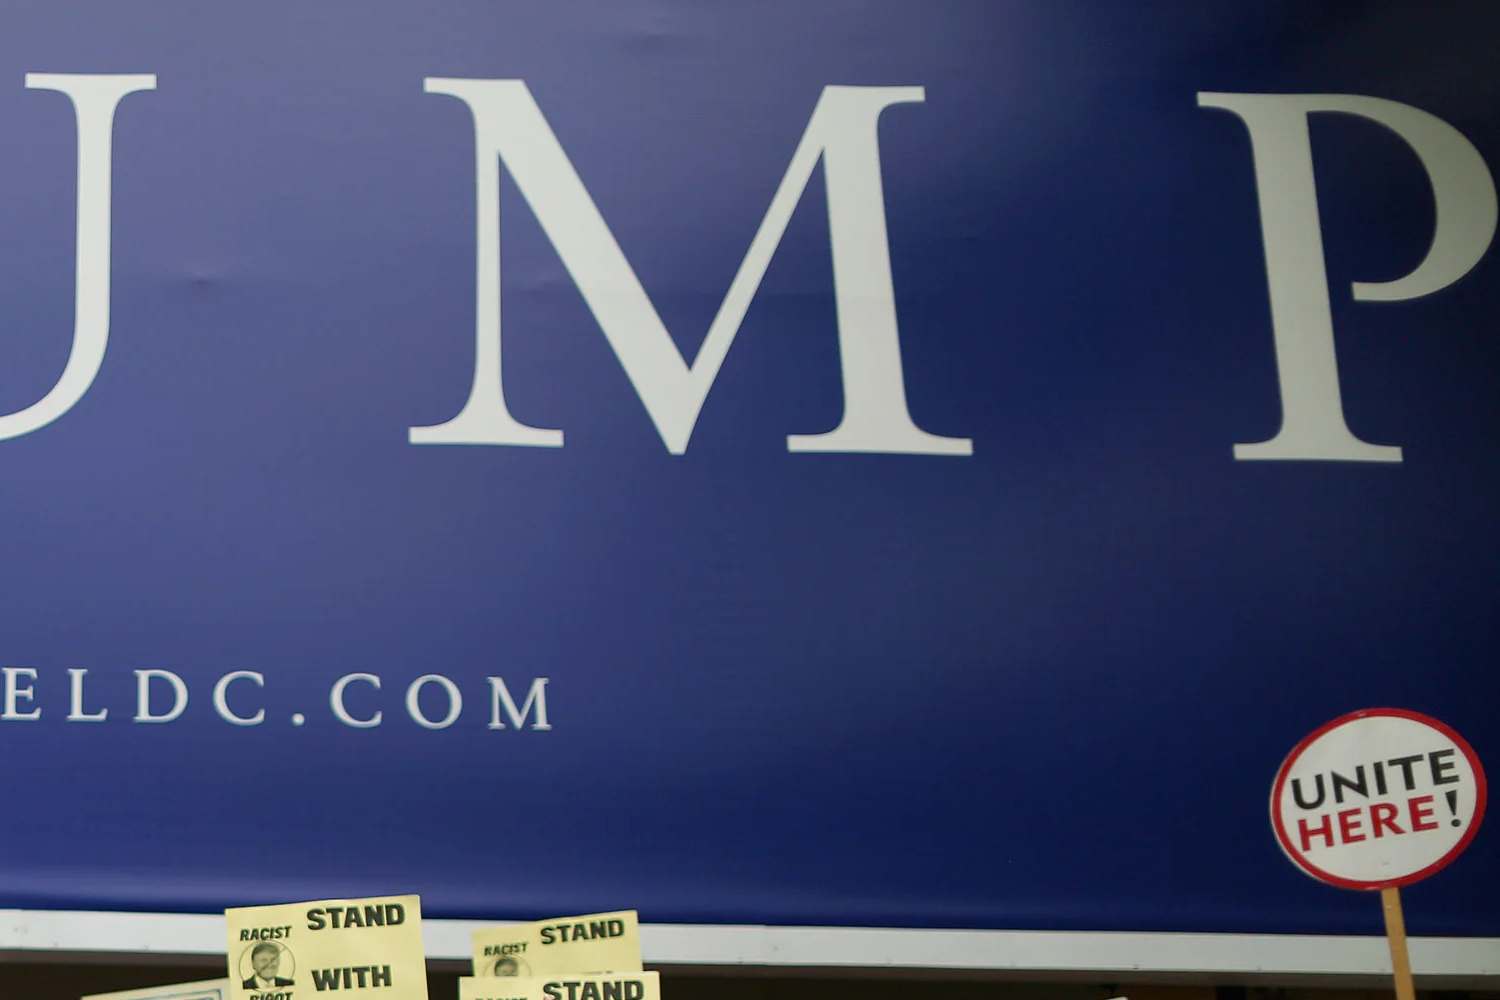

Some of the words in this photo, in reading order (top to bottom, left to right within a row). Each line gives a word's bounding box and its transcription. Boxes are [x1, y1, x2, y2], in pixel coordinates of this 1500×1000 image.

[1291, 749, 1460, 810] UNITE
[1298, 789, 1462, 852] HERE!
[307, 903, 405, 931] STAND
[240, 926, 292, 941] RACIST
[540, 919, 625, 946] STAND
[484, 942, 528, 956] RACIST
[311, 965, 392, 991] WITH
